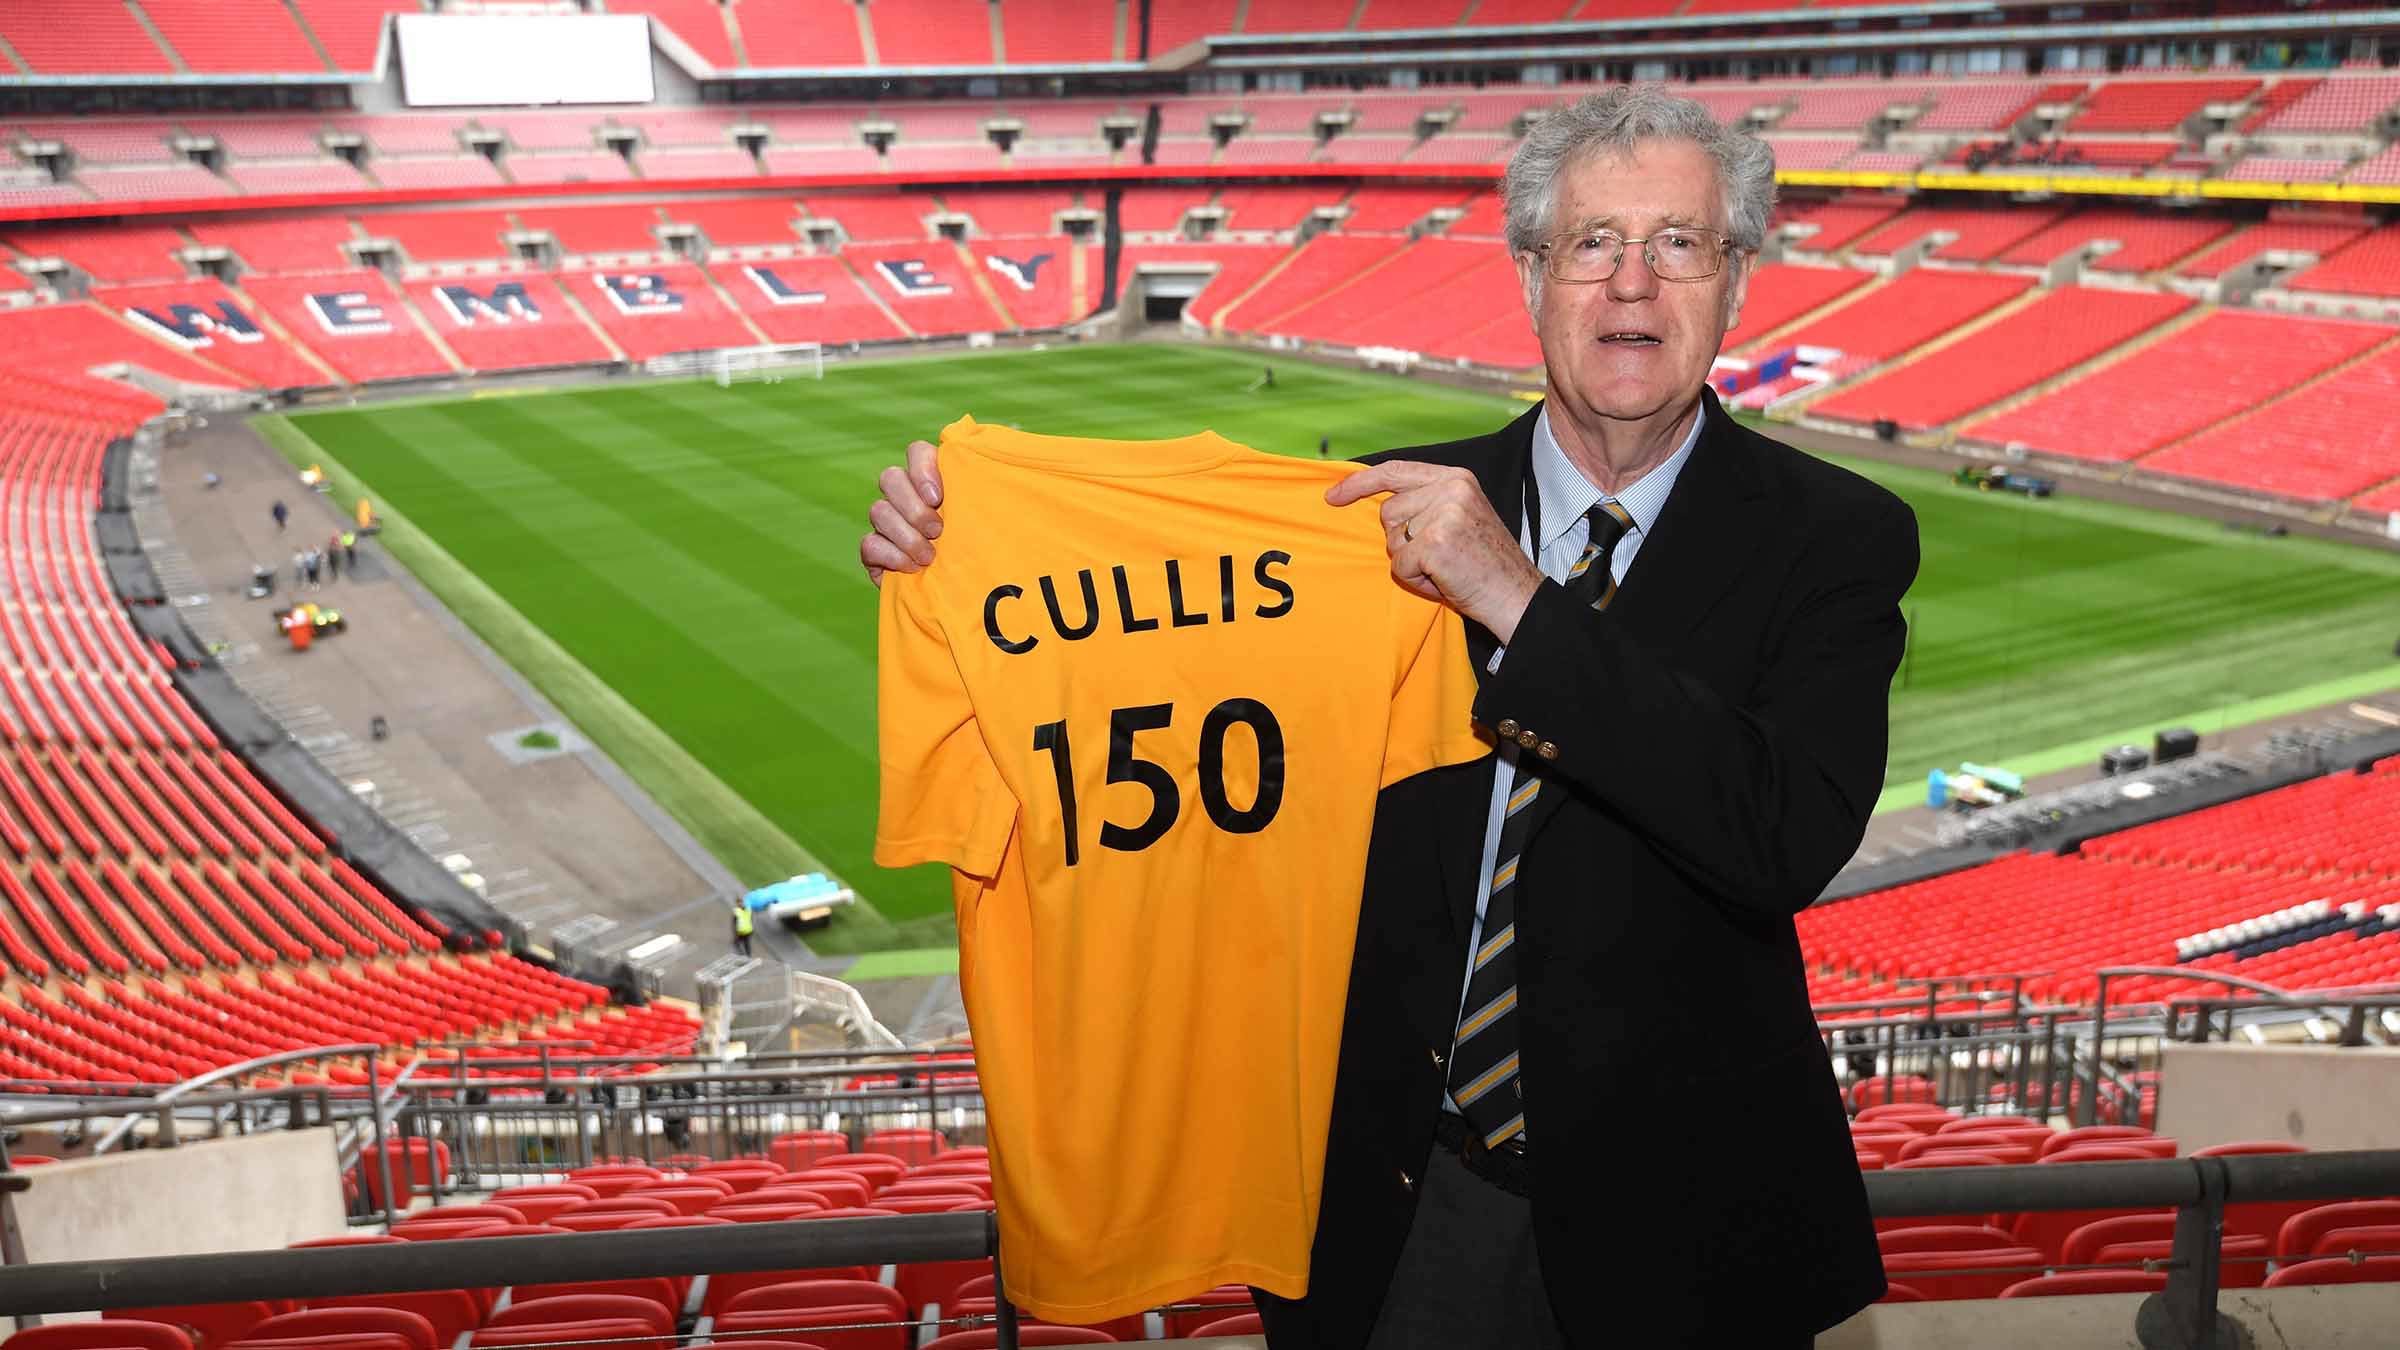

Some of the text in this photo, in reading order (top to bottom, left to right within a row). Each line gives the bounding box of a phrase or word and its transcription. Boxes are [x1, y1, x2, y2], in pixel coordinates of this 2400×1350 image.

[125, 253, 1055, 348] WEMBLEY
[983, 550, 1295, 654] CULLIS
[1033, 698, 1286, 867] 150
